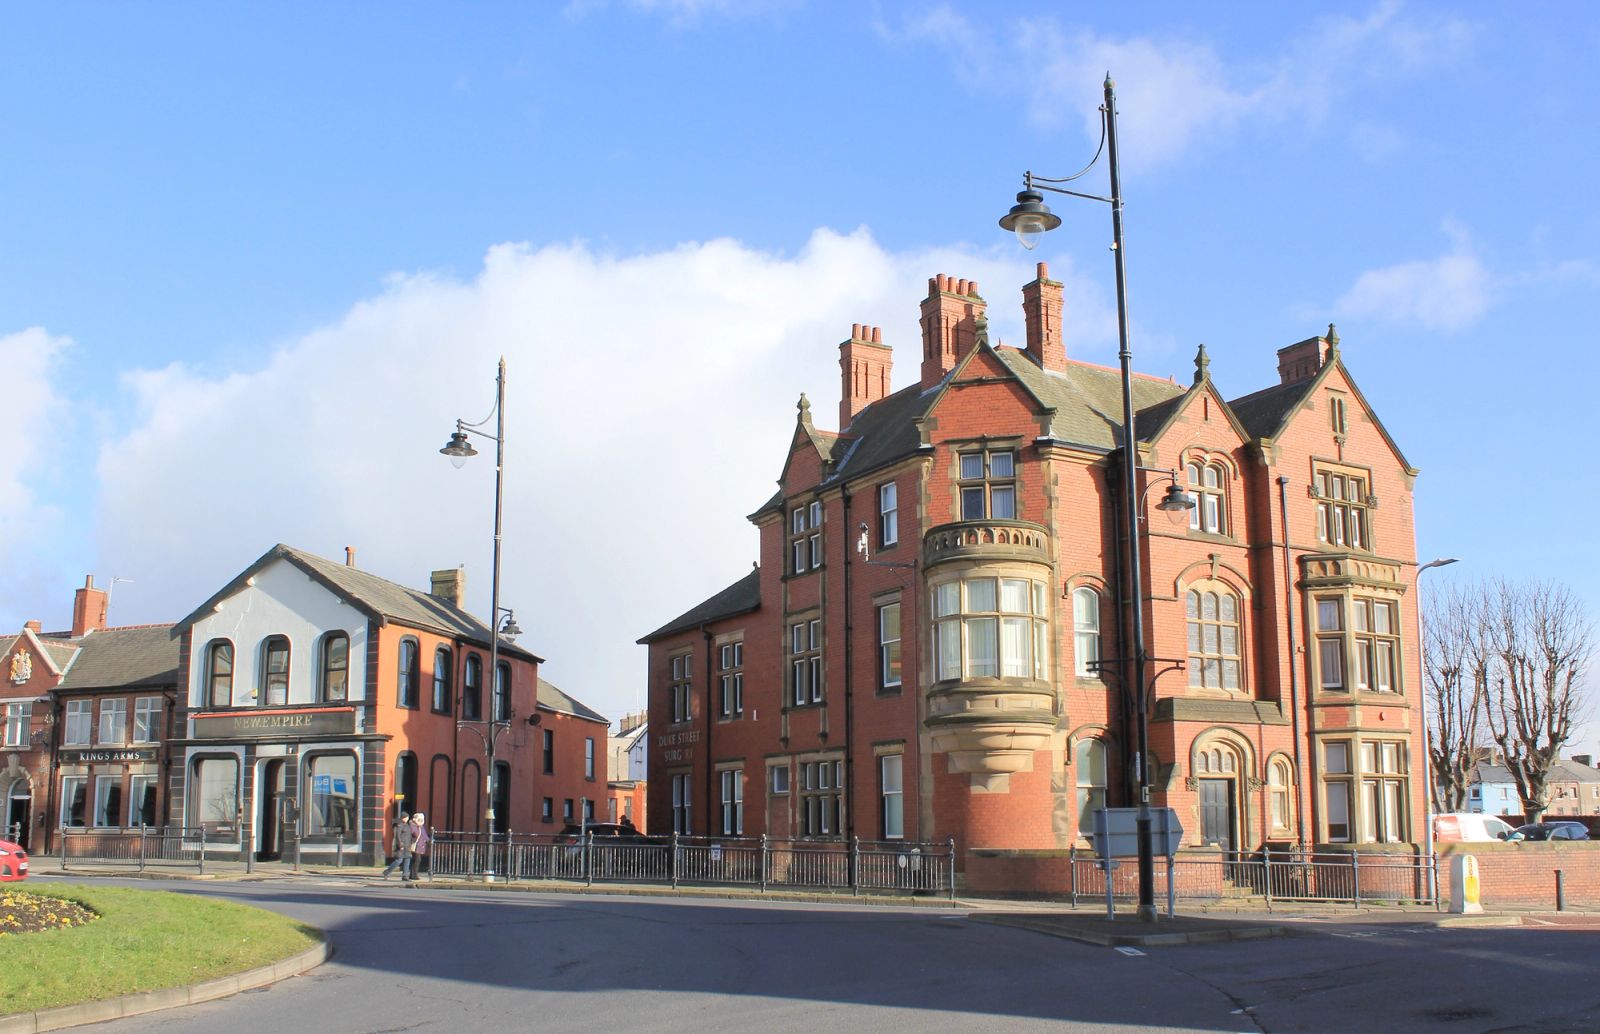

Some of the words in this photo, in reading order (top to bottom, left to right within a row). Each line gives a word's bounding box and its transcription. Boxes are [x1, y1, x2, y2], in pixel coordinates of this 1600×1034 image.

[677, 729, 700, 744] STREET
[79, 752, 110, 761] KINGS
[113, 751, 140, 760] ARMS
[664, 747, 693, 761] SURGRY
